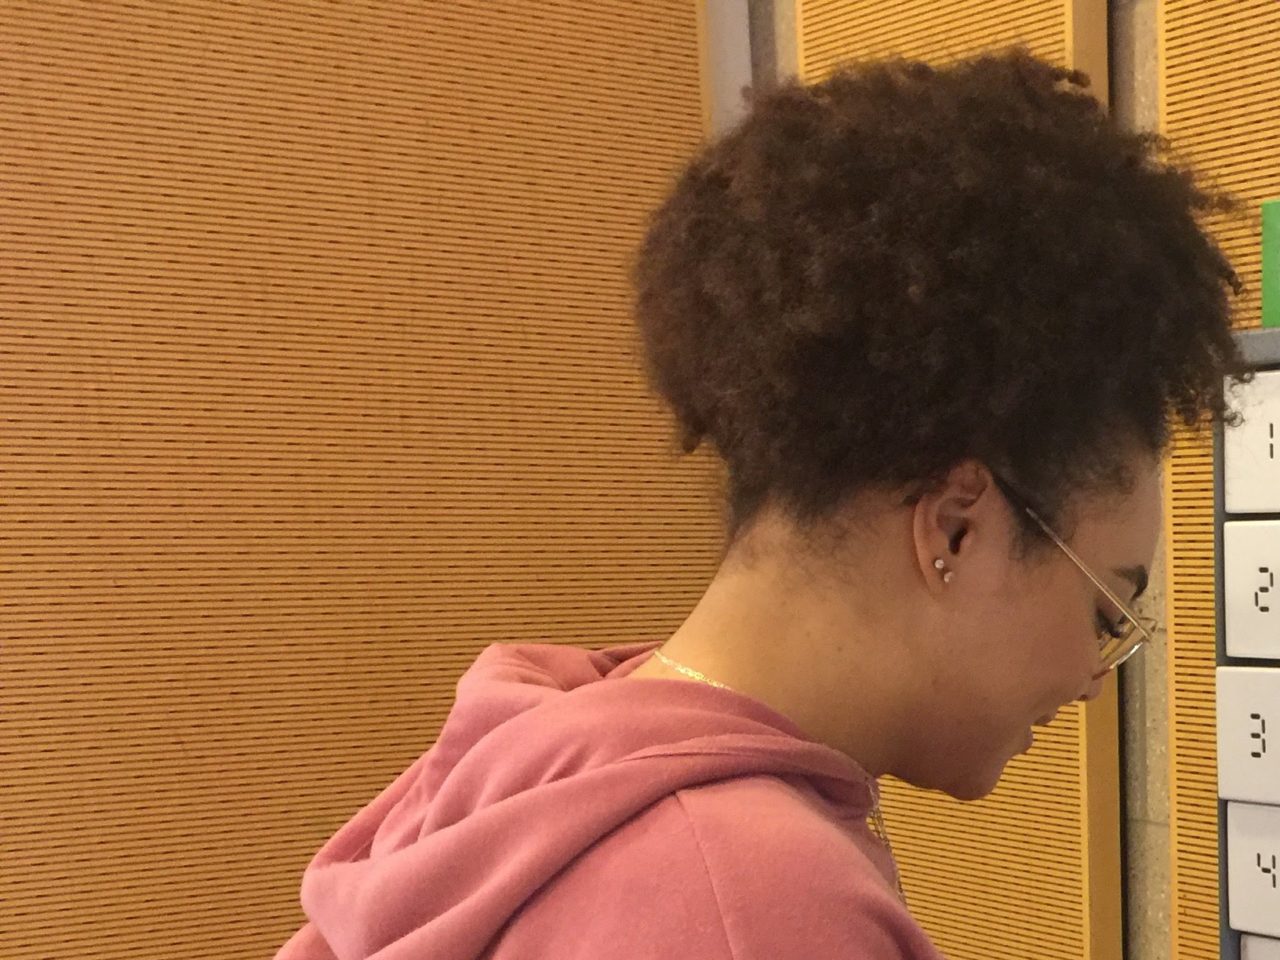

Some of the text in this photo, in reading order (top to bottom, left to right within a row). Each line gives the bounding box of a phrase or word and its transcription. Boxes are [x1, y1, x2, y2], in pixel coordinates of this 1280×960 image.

[1269, 422, 1274, 459] 1
[1254, 566, 1274, 613] 2
[1250, 713, 1266, 758] 3
[1256, 852, 1277, 888] 4
